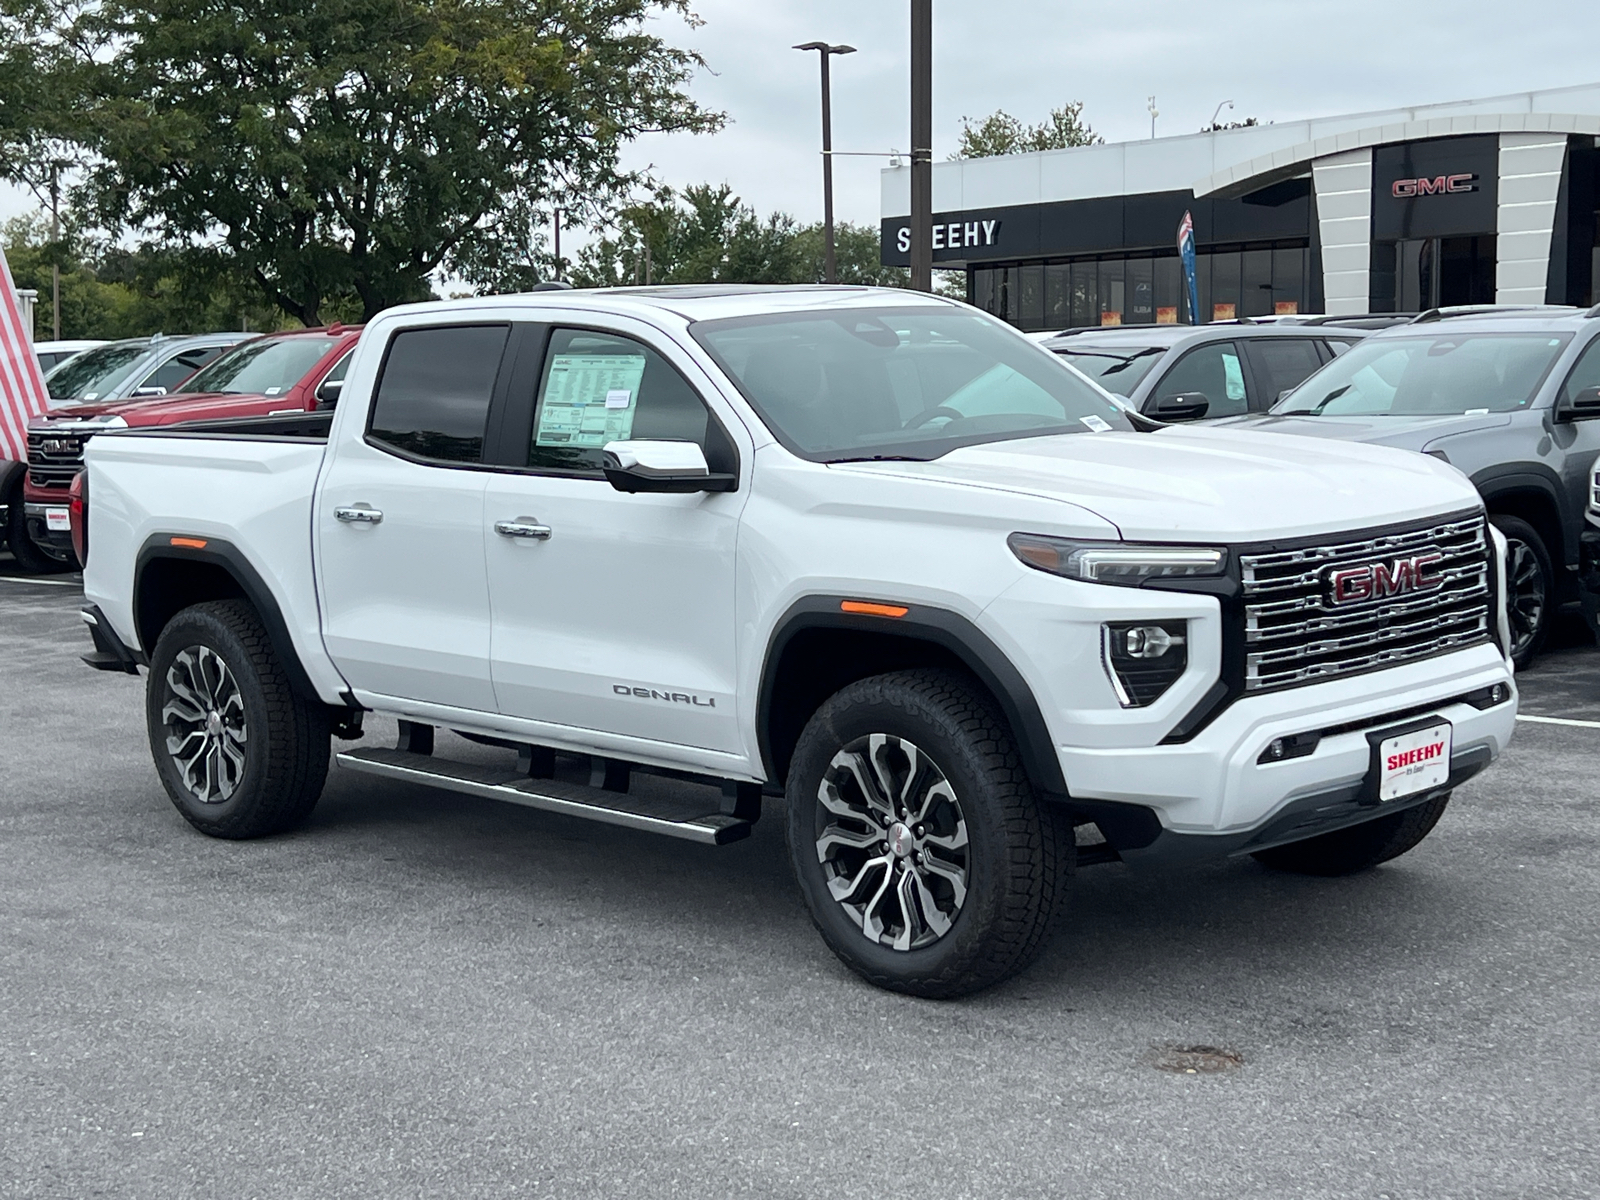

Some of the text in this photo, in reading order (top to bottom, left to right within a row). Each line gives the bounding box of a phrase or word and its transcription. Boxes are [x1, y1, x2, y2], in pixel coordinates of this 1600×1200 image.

[1392, 173, 1472, 198] GMC
[897, 219, 996, 253] SEEHY
[1330, 553, 1444, 605] GMC
[613, 684, 716, 707] DENALI
[1387, 741, 1444, 771] SHEEHY
